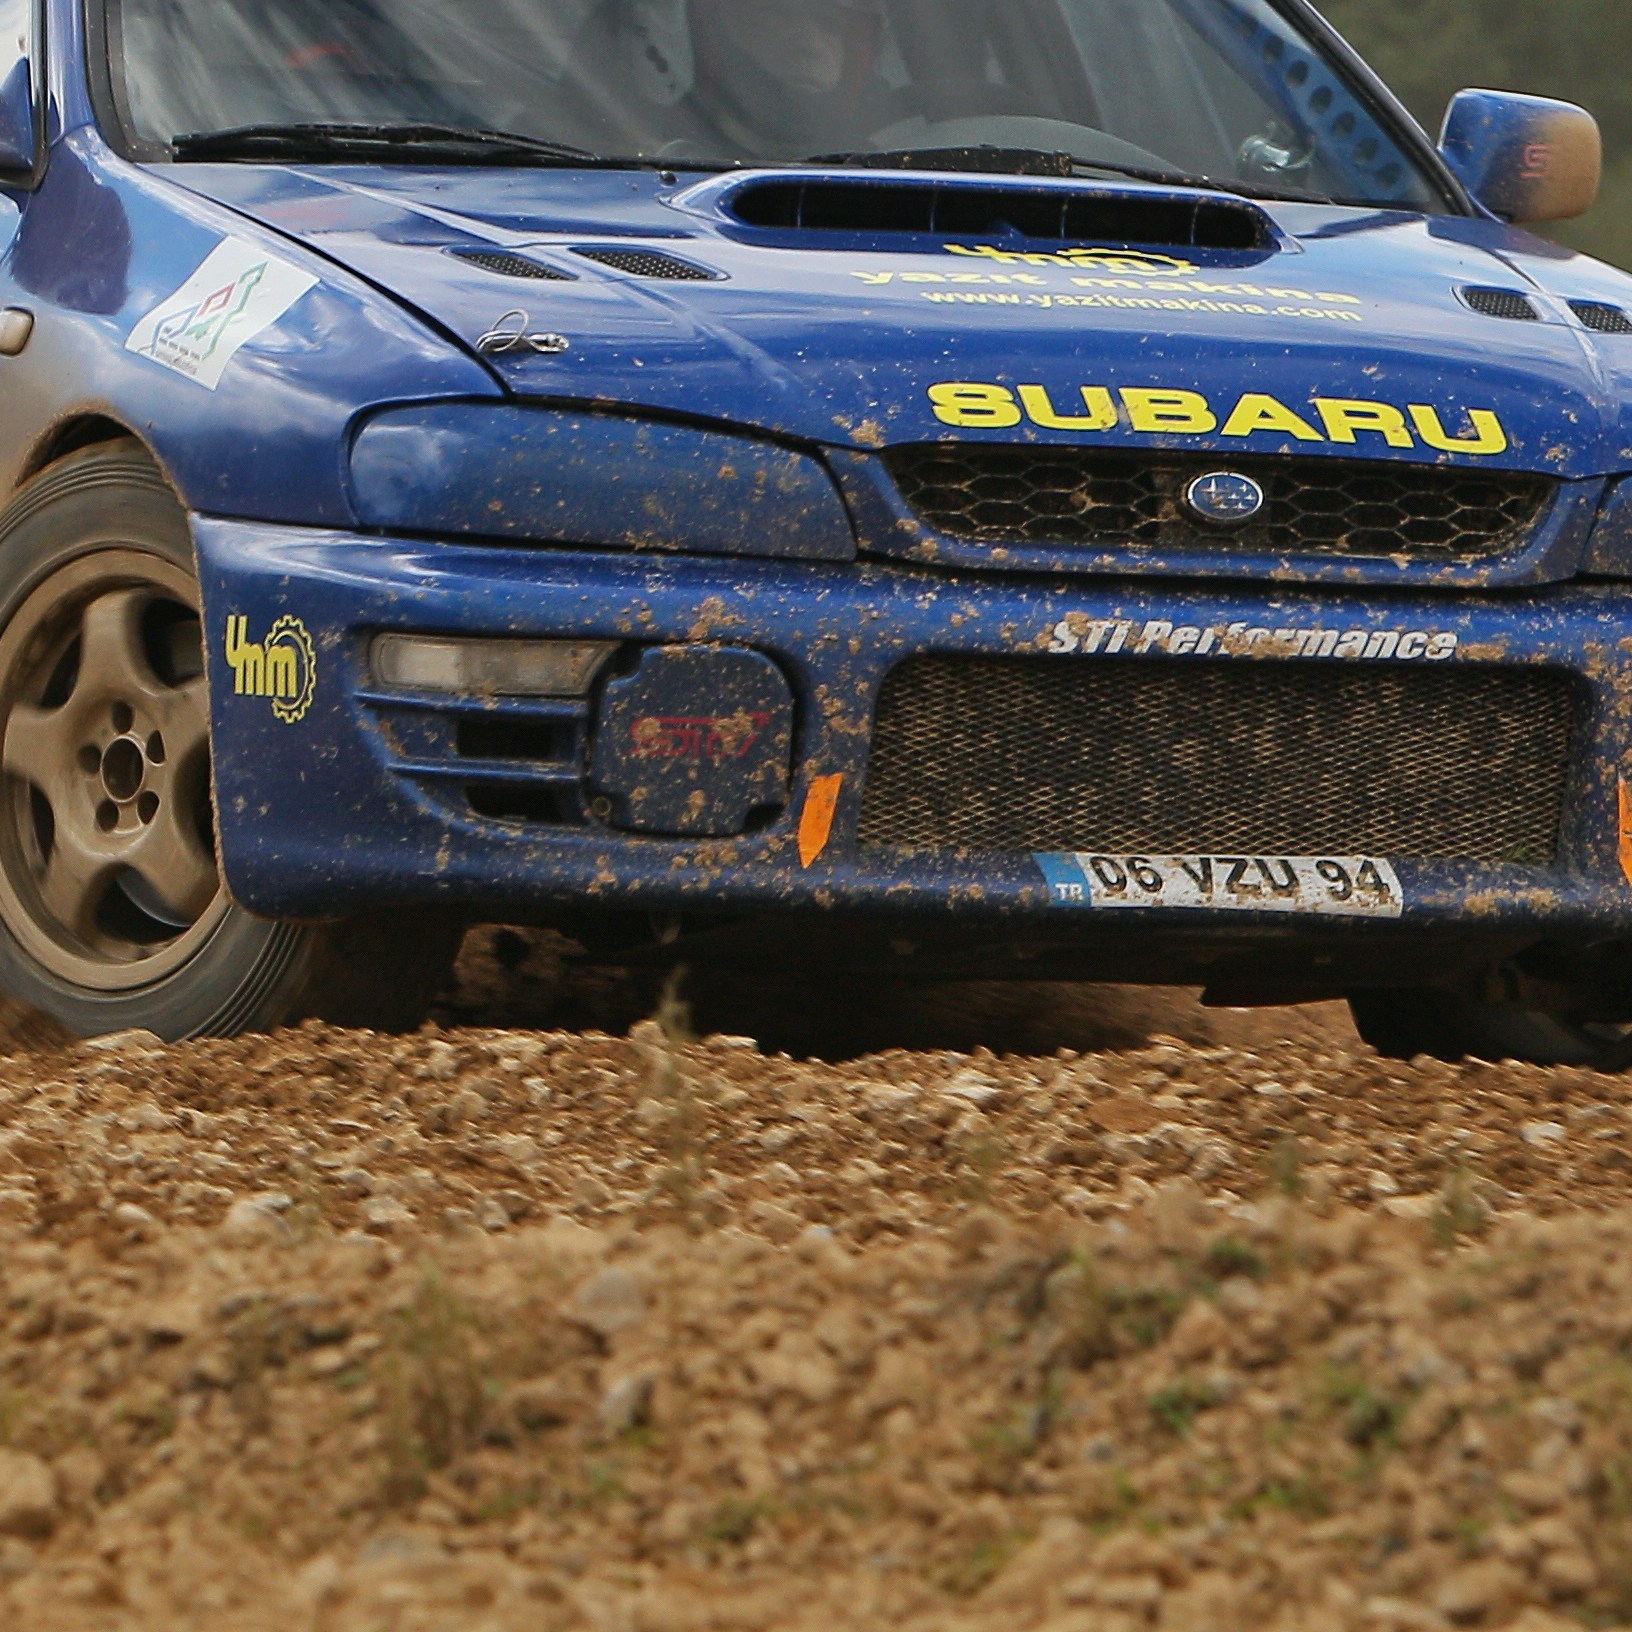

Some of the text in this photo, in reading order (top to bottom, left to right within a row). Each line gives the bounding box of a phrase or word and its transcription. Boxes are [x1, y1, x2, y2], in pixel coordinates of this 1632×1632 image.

[920, 289, 1363, 322] www.yazitmakina.com
[1070, 276, 1362, 305] makina
[926, 381, 1509, 455] SUBARU
[1047, 620, 1459, 660] STI Performance
[1055, 882, 1085, 901] TR
[1089, 855, 1391, 905] 06 VZU 94
